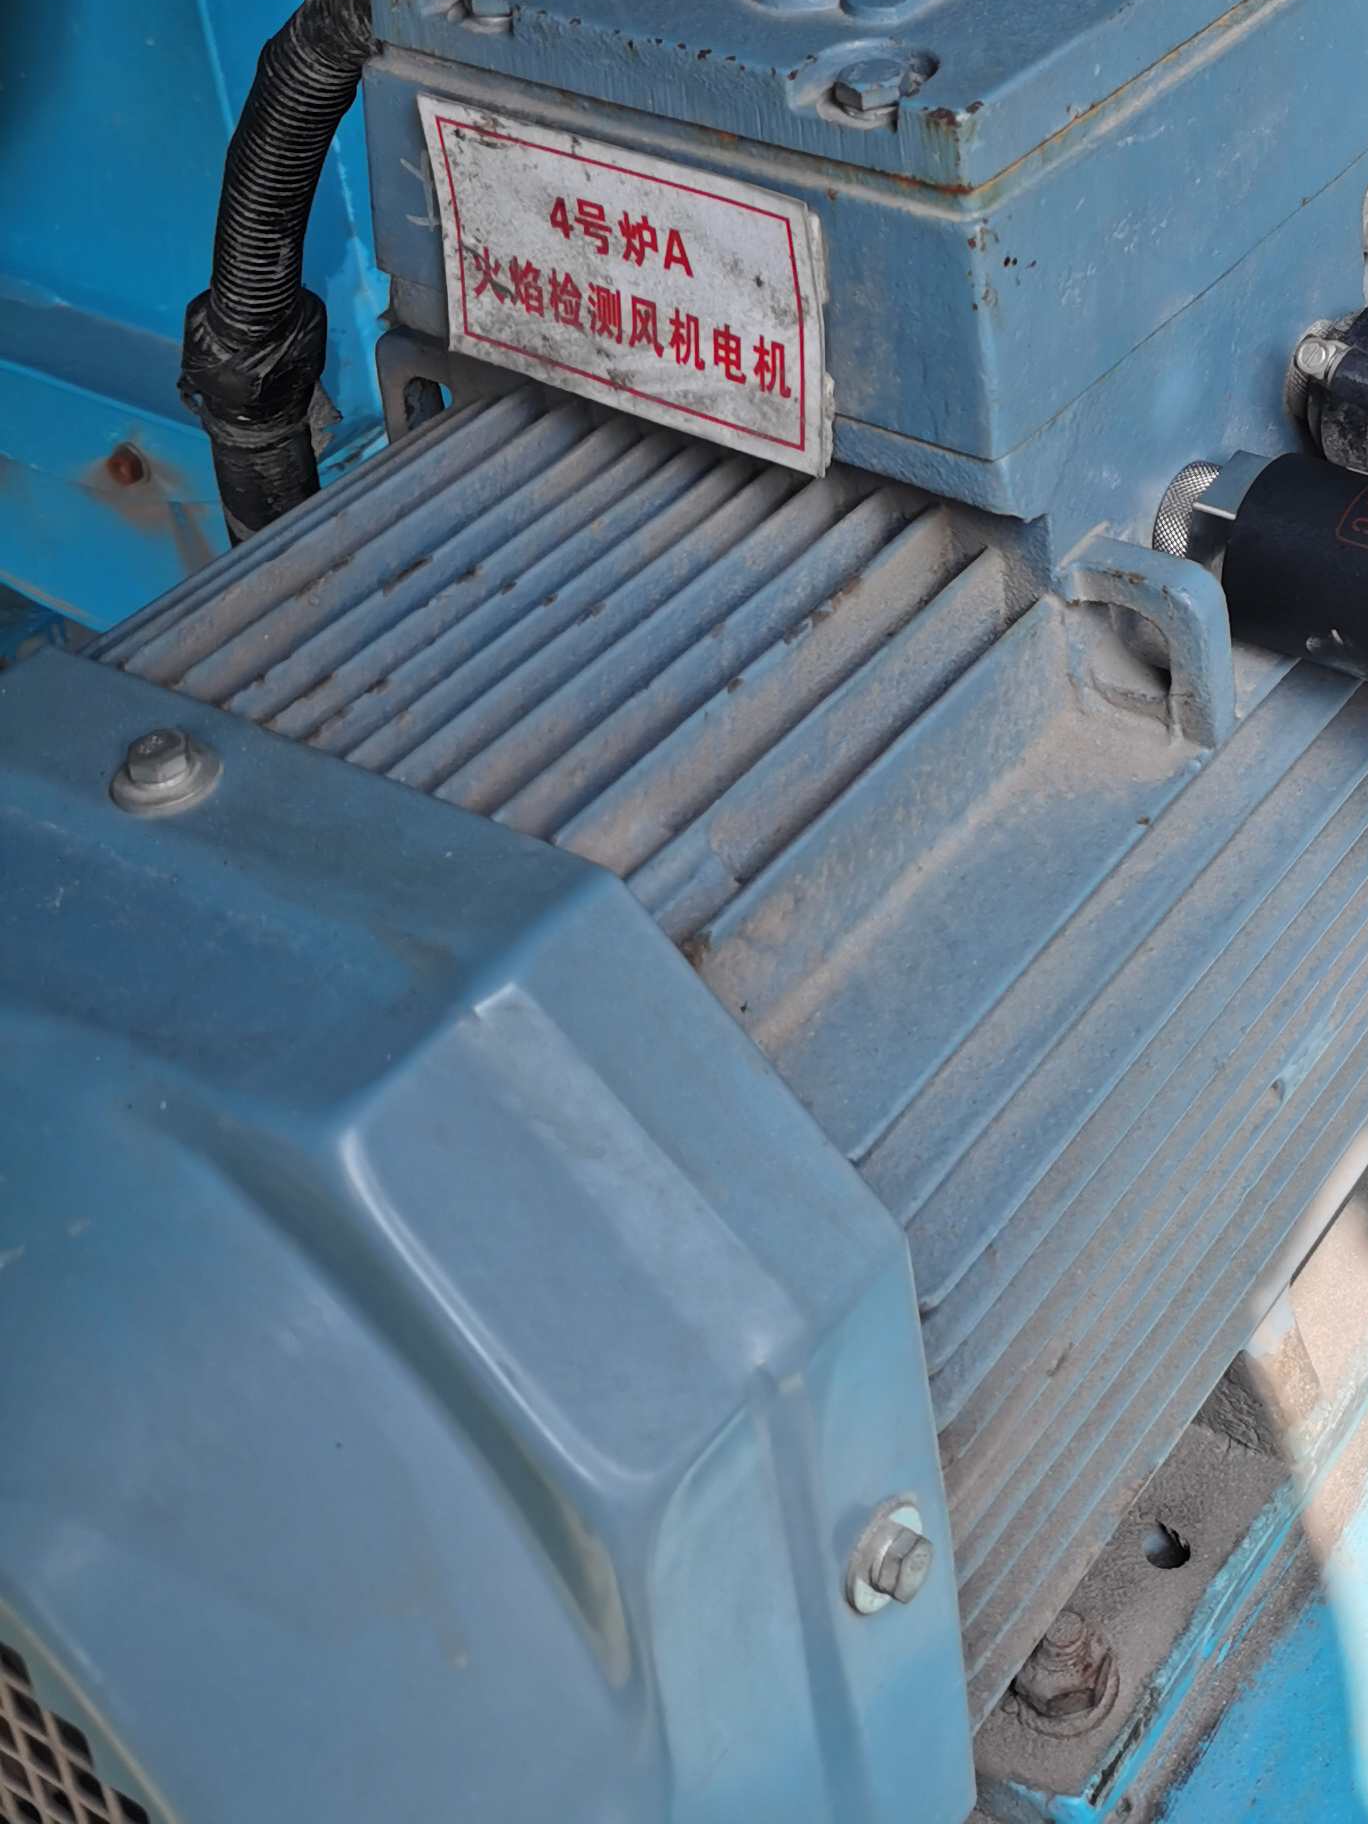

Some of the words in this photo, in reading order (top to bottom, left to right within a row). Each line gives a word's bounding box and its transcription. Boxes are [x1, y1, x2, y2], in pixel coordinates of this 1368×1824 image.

[548, 196, 695, 277] 4号炉A
[472, 247, 792, 399] 火焰检测风机电机
